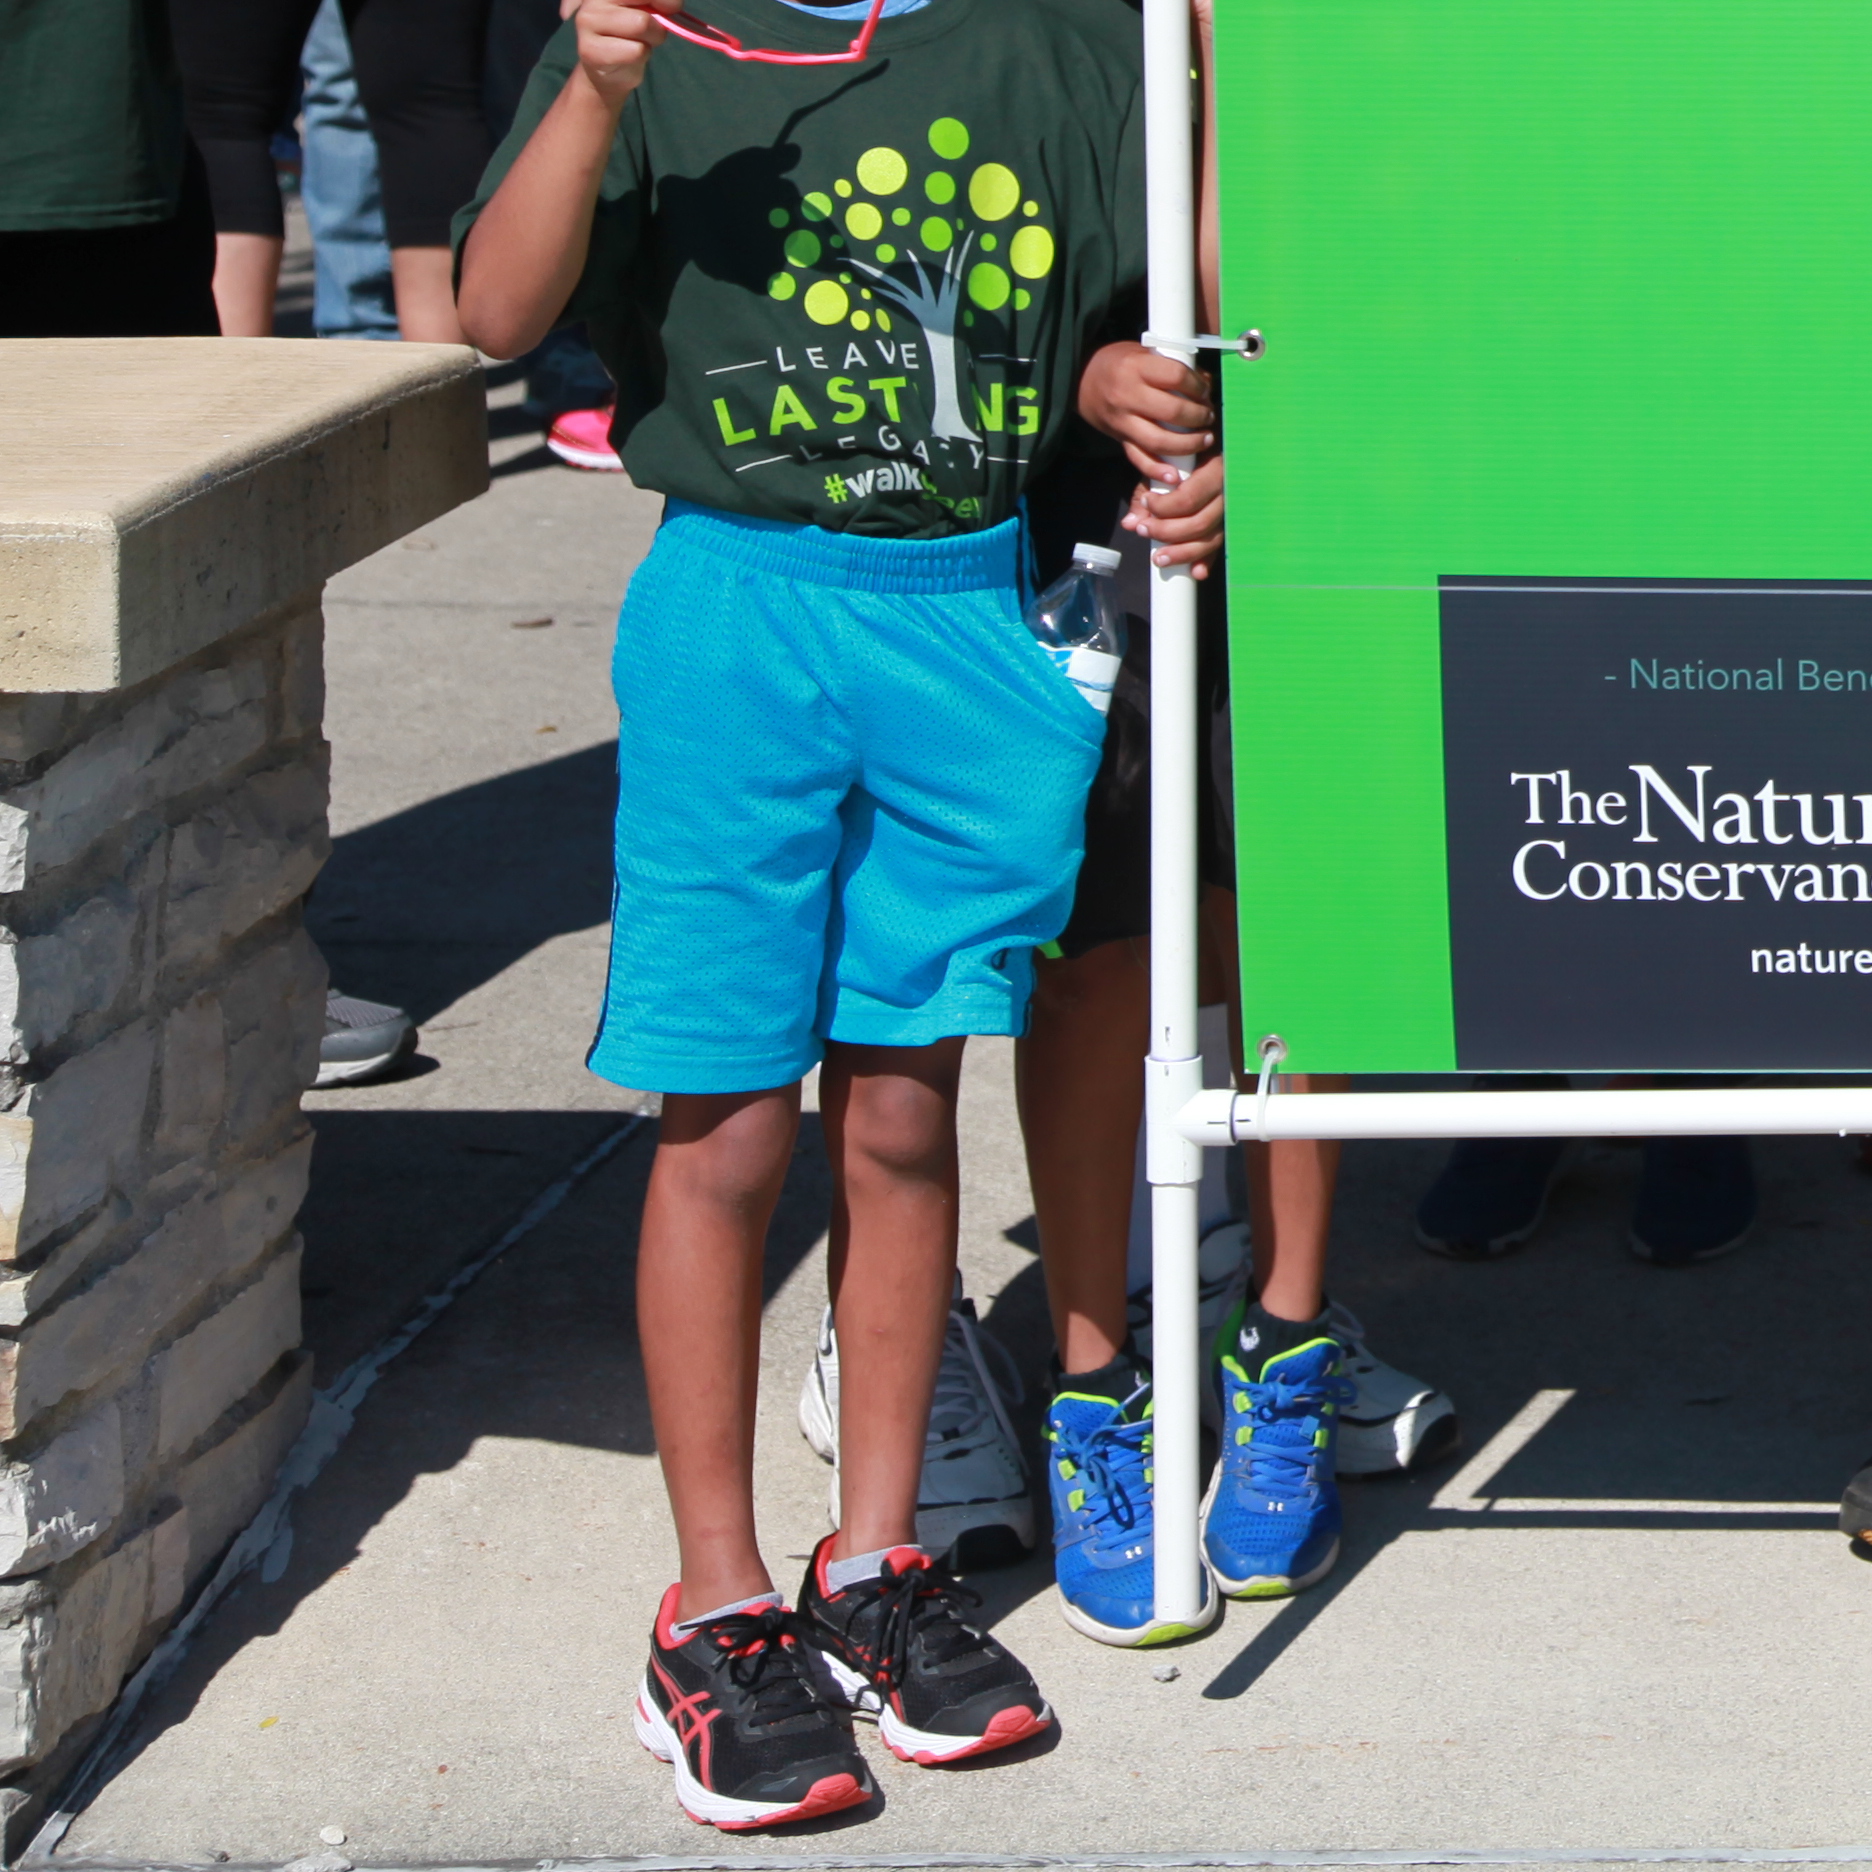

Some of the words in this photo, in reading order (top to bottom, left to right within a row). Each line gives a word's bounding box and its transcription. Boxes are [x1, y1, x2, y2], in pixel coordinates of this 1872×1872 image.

[775, 339, 919, 373] LEAVE
[712, 376, 1040, 446] LASTNG
[1629, 656, 1785, 693] National
[1509, 770, 1628, 826] The
